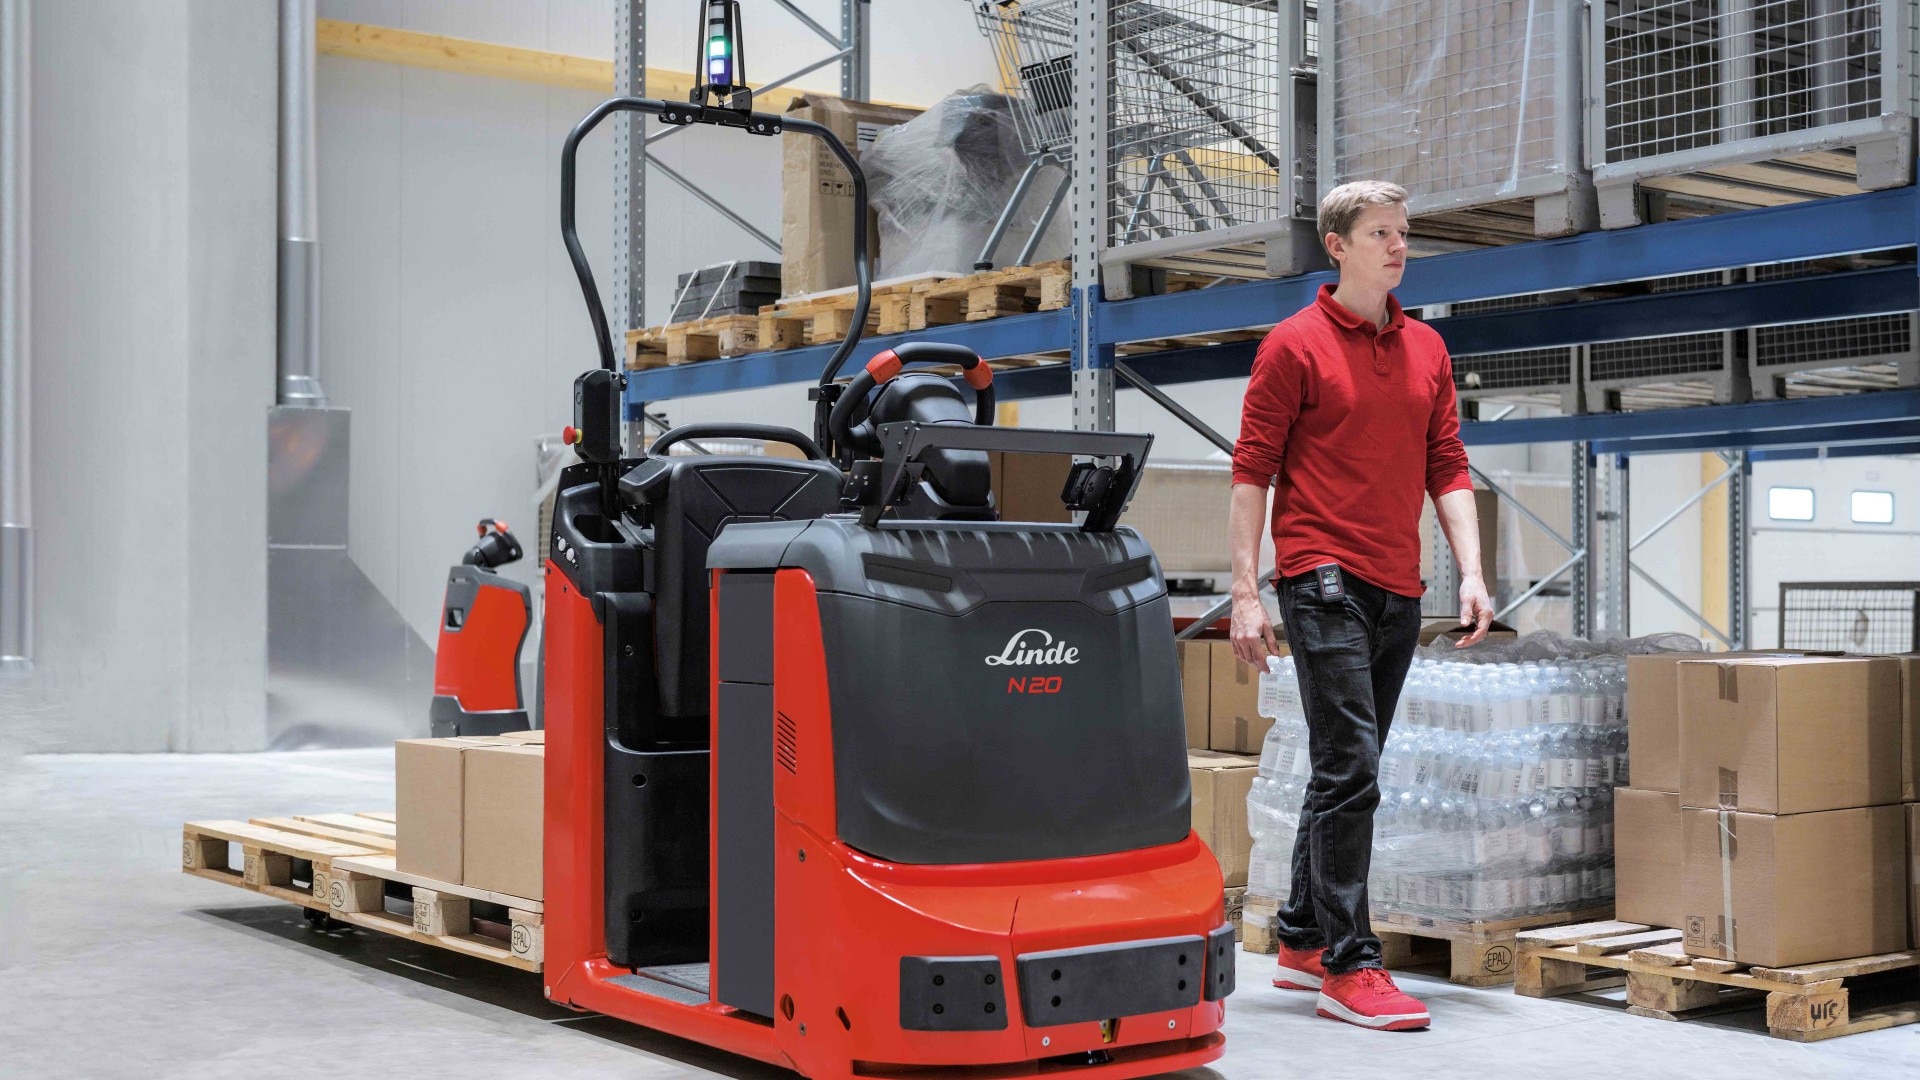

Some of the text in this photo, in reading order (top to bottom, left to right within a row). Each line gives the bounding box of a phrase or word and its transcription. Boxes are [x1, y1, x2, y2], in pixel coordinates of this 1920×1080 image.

[985, 628, 1080, 666] Linde
[513, 930, 528, 948] EPAL
[1487, 951, 1508, 968] EPAL
